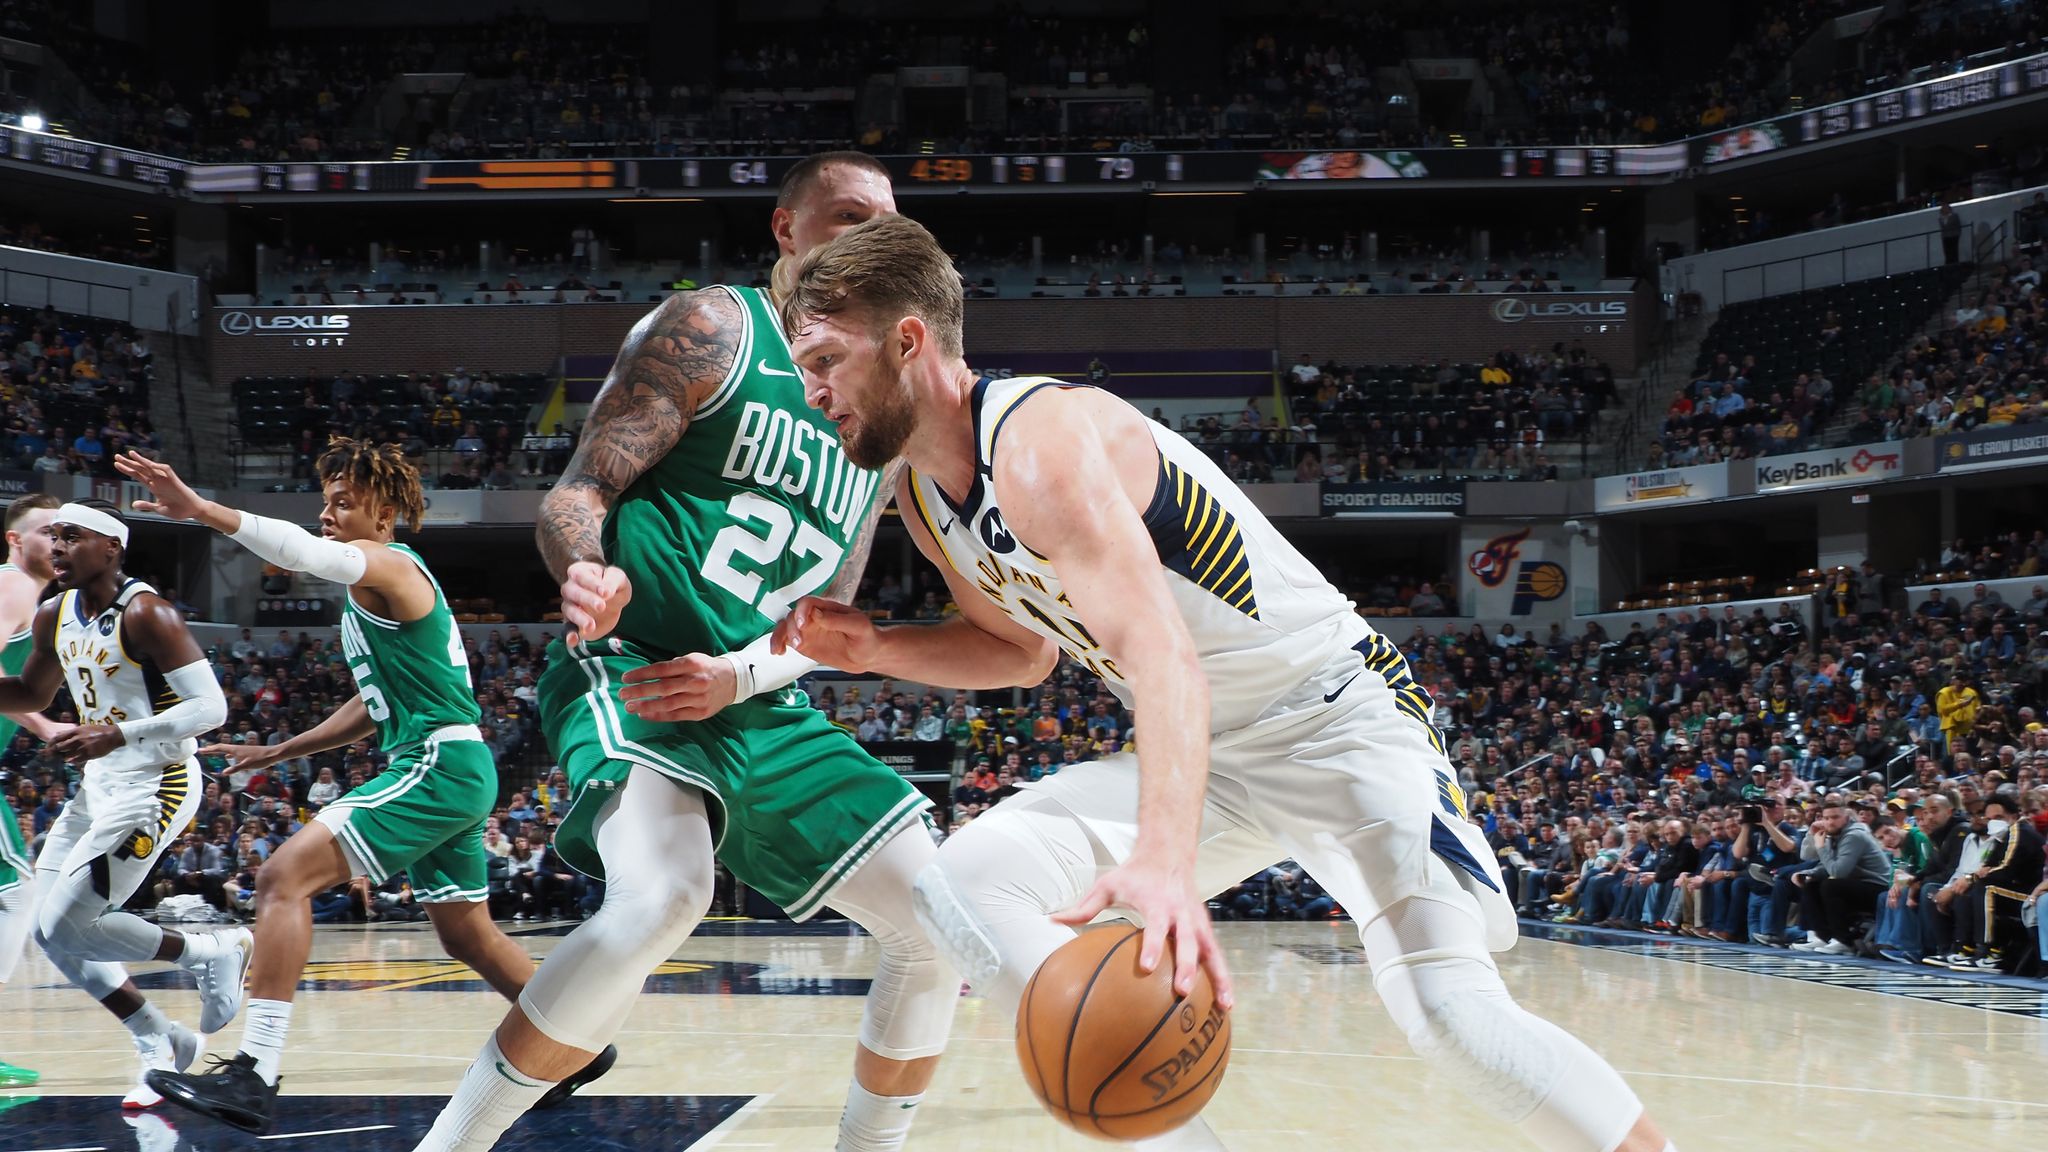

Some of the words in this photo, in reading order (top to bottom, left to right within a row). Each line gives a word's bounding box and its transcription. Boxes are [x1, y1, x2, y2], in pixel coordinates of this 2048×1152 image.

[729, 161, 769, 184] 64
[1096, 157, 1135, 180] 79
[1531, 301, 1627, 316] LEXUS
[255, 314, 351, 329] LEXUS
[293, 337, 345, 347] LOFT
[1968, 443, 1983, 457] WE
[1983, 439, 2011, 455] GROW
[721, 401, 879, 544] BOSTON
[1758, 457, 1848, 486] KeyBank
[1323, 493, 1377, 506] SPORT
[1379, 492, 1463, 506] GRAPHICS
[700, 491, 846, 625] 27
[78, 666, 97, 709] 3
